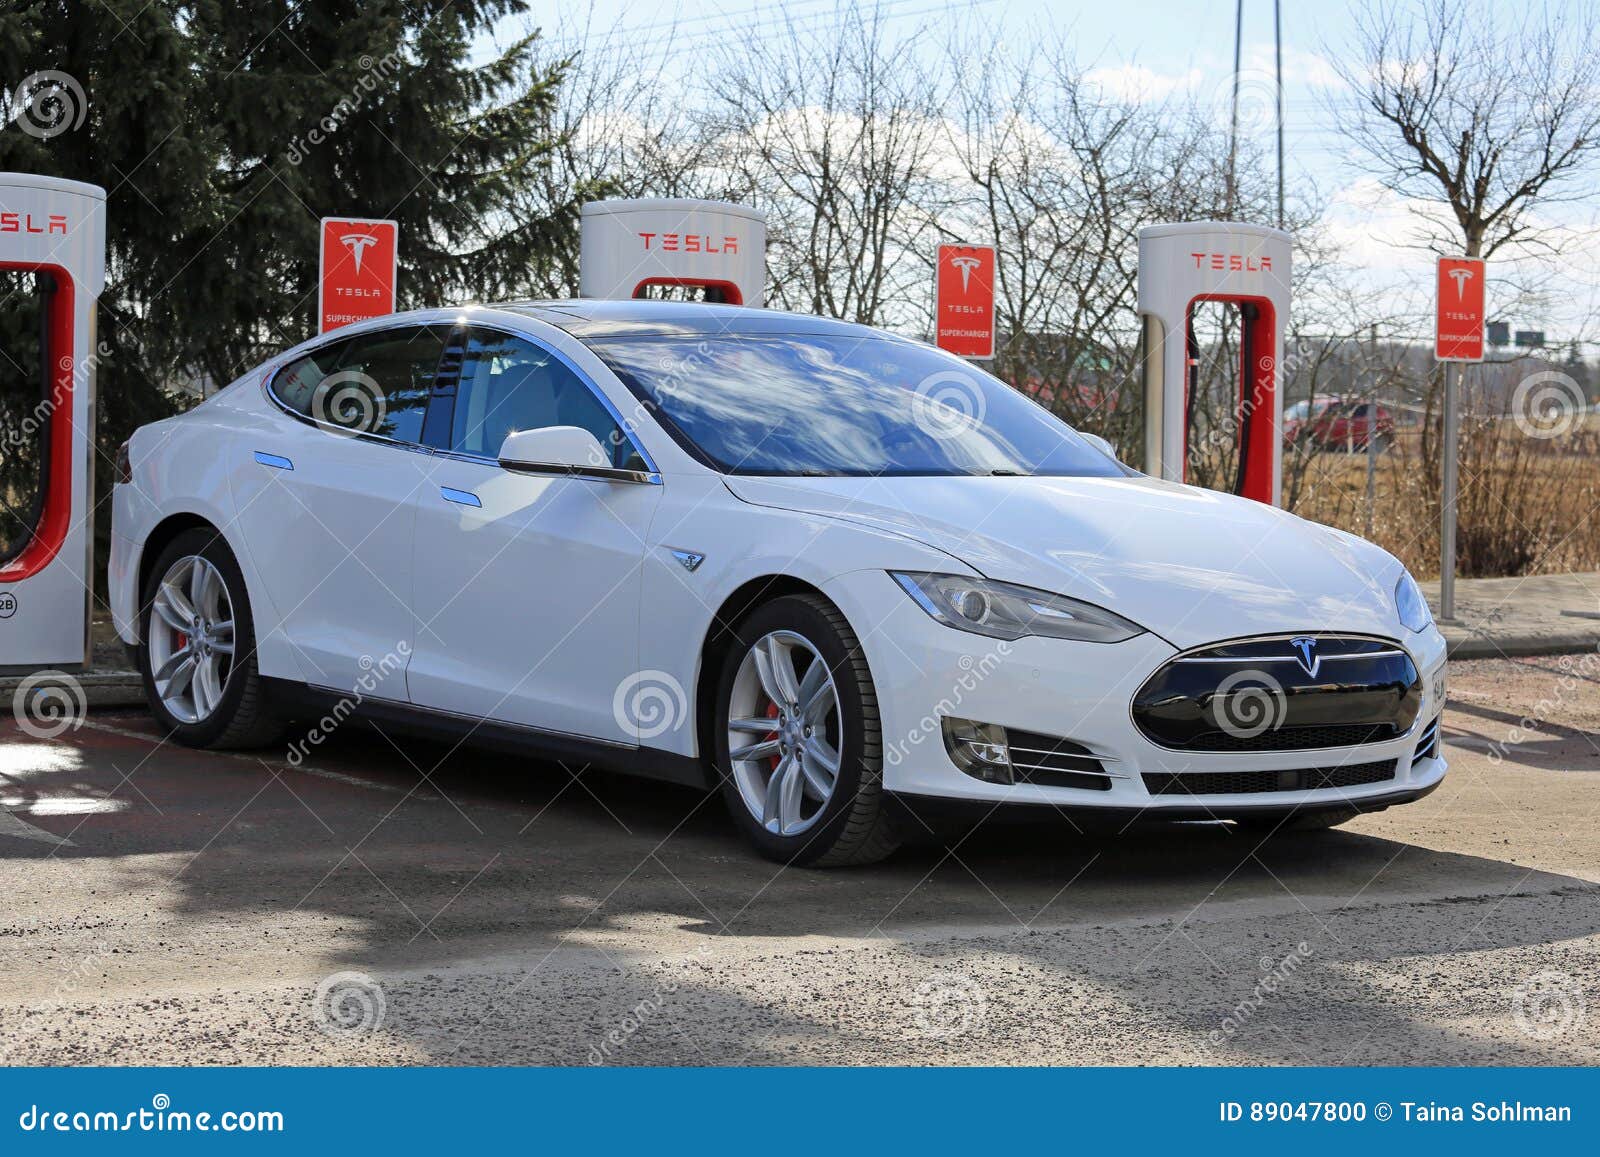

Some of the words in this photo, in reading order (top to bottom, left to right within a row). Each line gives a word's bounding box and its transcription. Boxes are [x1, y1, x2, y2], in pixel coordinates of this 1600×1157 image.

[638, 232, 738, 254] TESLA
[1191, 252, 1272, 271] TESLA
[336, 287, 381, 297] TESLA
[948, 304, 984, 314] TESLA
[940, 328, 990, 338] SUPERCHARGER
